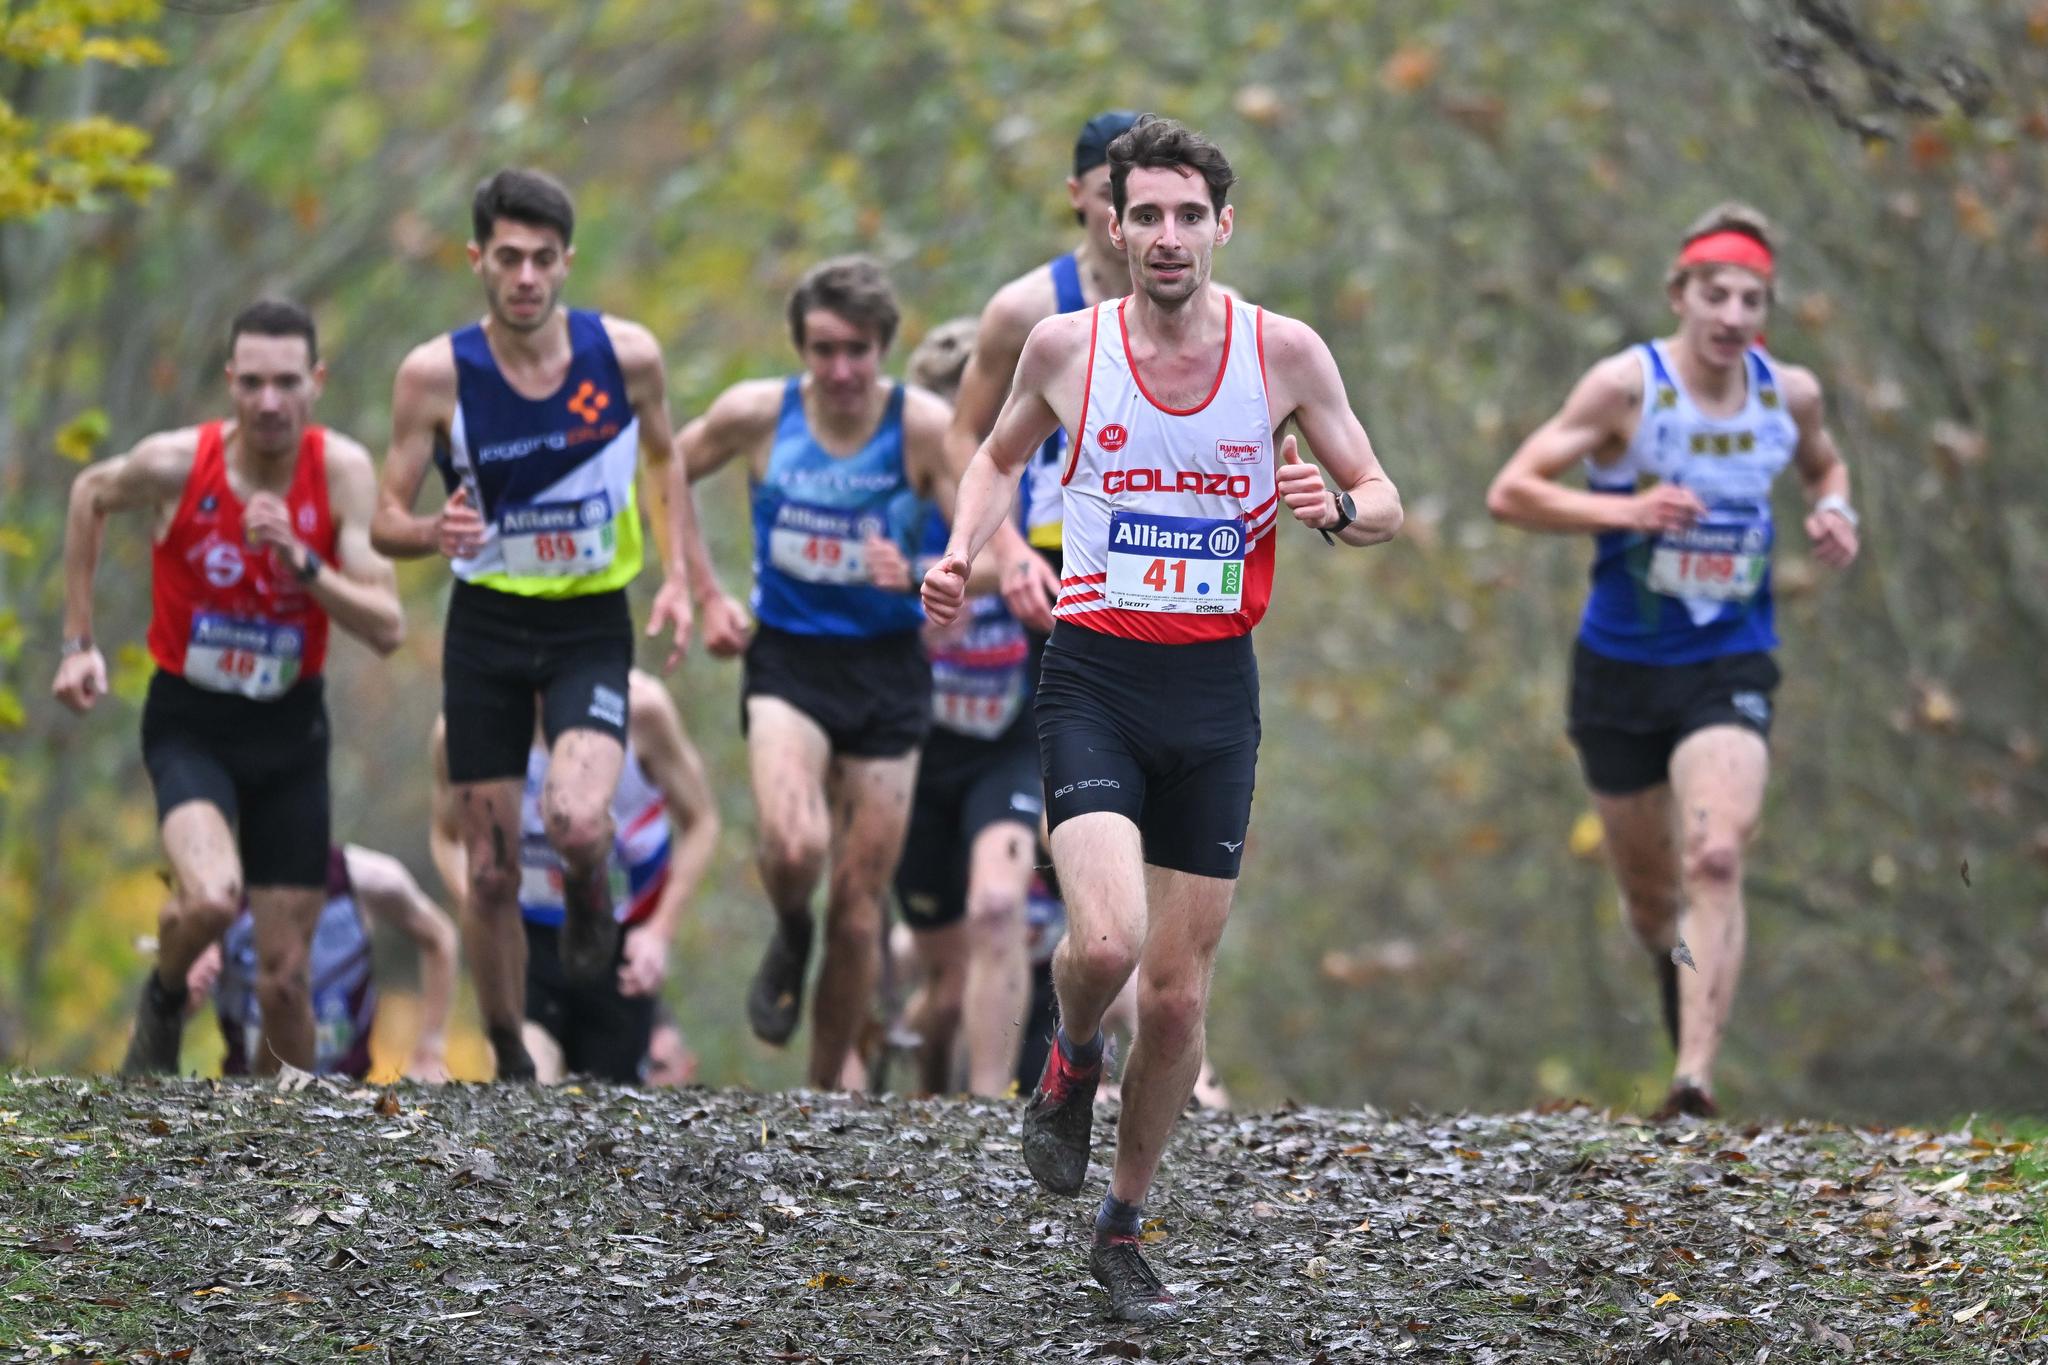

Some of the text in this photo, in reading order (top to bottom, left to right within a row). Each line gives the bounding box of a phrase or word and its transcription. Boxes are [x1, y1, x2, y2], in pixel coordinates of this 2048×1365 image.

[1103, 468, 1250, 498] GOLAZO
[534, 532, 577, 561] 89
[803, 535, 842, 567] 49
[1115, 522, 1203, 551] Allianz
[1142, 558, 1187, 593] 41
[1226, 563, 1238, 592] 2024
[1055, 779, 1120, 799] BG 3000
